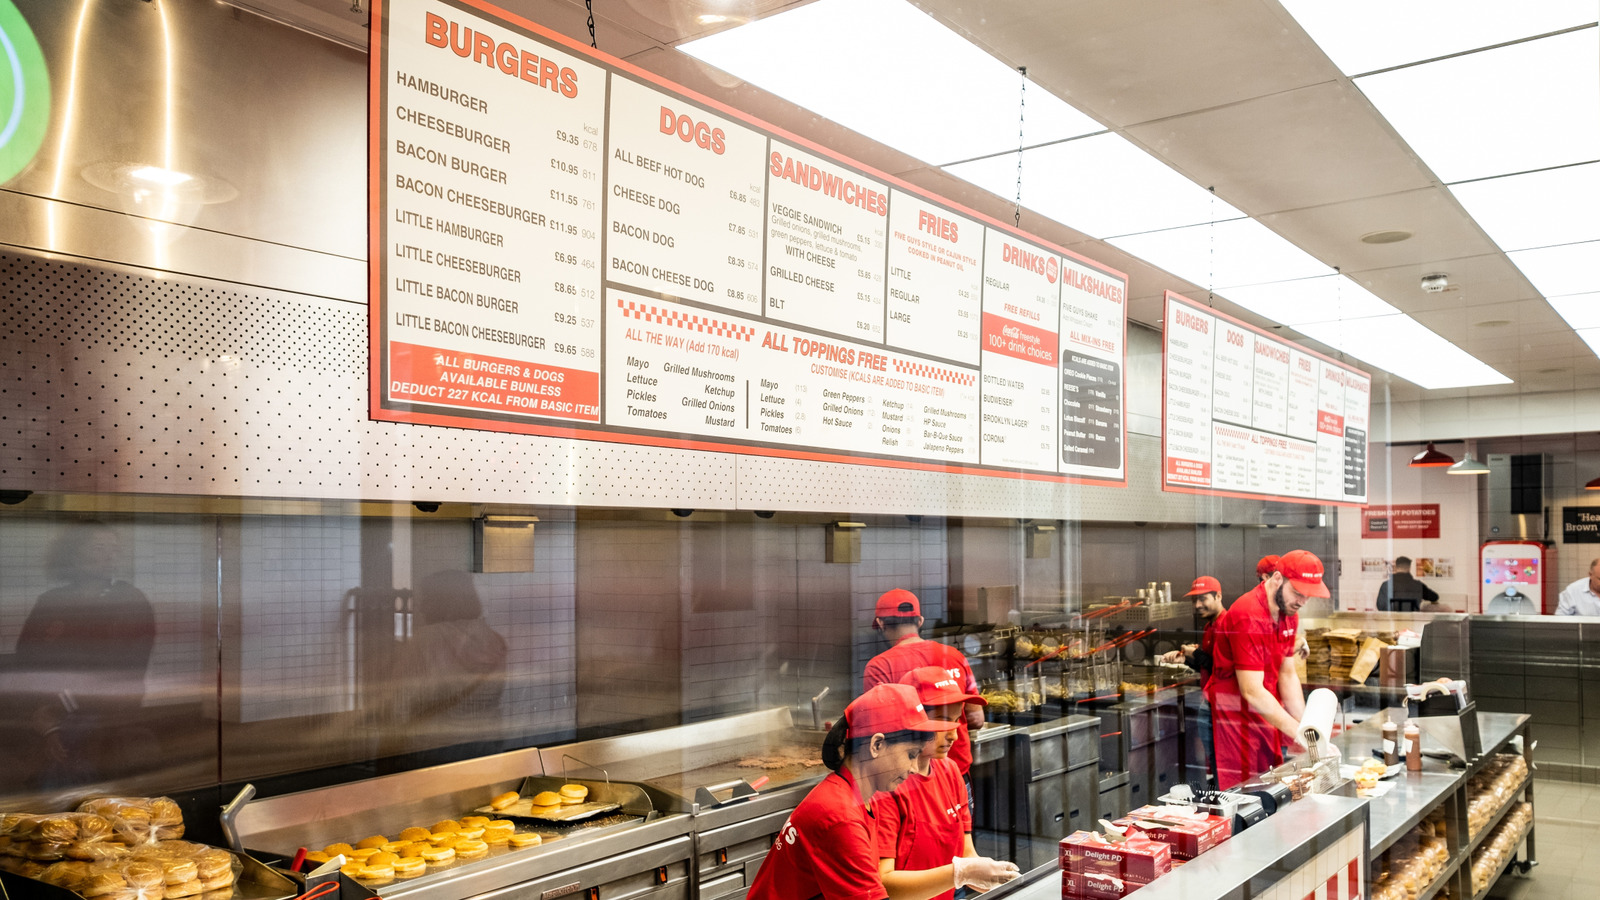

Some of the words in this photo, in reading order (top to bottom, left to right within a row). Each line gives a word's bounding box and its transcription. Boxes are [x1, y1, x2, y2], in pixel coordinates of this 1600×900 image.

[425, 12, 577, 98] BURGERS
[397, 71, 487, 113] HAMBURGER
[557, 130, 579, 145] £9.35
[397, 106, 510, 153] CHEESEBURGER
[551, 159, 578, 175] £10.95
[660, 106, 725, 155] DOGS
[397, 140, 446, 166] BACON
[452, 157, 506, 184] BURGER
[551, 190, 578, 205] £11.55
[615, 148, 633, 164] ALL
[637, 155, 661, 172] BEEF
[664, 165, 683, 180] HOT
[685, 172, 704, 188] DOG
[730, 190, 746, 203] £6.85
[770, 149, 887, 218] SANDWICHES
[397, 175, 443, 199] BACON
[447, 189, 545, 226] CHEESEBURGER
[550, 220, 577, 235] £11.95
[614, 185, 655, 207] CHEESE
[659, 199, 680, 214] DOG
[729, 223, 745, 235] £7.85
[772, 215, 790, 228] Grilled
[792, 224, 813, 236] onions,
[813, 231, 830, 241] grilled
[773, 203, 801, 221] VEGGIE
[803, 214, 842, 235] SANDWICH
[919, 210, 958, 243] FRIES
[396, 209, 433, 230] LITTLE
[437, 219, 503, 247] HAMBURGER
[555, 252, 577, 265] £6.95
[613, 221, 649, 241] BACON
[653, 232, 674, 248] DOG
[728, 256, 744, 268] £8.35
[771, 229, 788, 239] green
[789, 235, 813, 248] peppers,
[815, 241, 833, 254] lettuce
[833, 248, 838, 256] &
[840, 250, 857, 261] tomato
[786, 245, 804, 259] WITH
[807, 252, 835, 268] CHEESE
[1003, 243, 1045, 275] DRINKS
[396, 243, 432, 263] LITTLE
[436, 253, 520, 282] CHEESEBURGER
[555, 282, 576, 295] £8.65
[613, 257, 649, 276] BACON
[652, 268, 691, 287] CHEESE
[694, 278, 714, 292] DOG
[727, 289, 744, 300] £8.85
[770, 266, 803, 283] GRILLED
[806, 276, 834, 292] CHEESE
[891, 267, 911, 280] LITTLE
[986, 276, 1009, 290] REGULAR
[1063, 267, 1122, 304] MILKSHAKES
[396, 278, 433, 297] LITTLE
[437, 286, 473, 305] BACON
[477, 294, 518, 313] BURGER
[555, 312, 576, 325] £9.25
[770, 297, 785, 309] BLT
[891, 288, 919, 303] REGULAR
[890, 311, 910, 323] LARGE
[1004, 303, 1018, 314] FREE
[1019, 308, 1040, 321] REFILLS
[1176, 309, 1208, 335] BURGERS
[396, 312, 430, 330] LITTLE
[434, 319, 468, 336] BACON
[472, 326, 545, 349] CHEESEBURGER
[555, 343, 576, 355] £9.65
[625, 328, 642, 341] ALL
[646, 331, 663, 345] THE
[666, 335, 684, 348] WAY
[686, 340, 705, 353] (Add
[707, 344, 720, 356] 170
[722, 346, 739, 361] kcal)
[1019, 330, 1040, 345] freestyle
[1070, 331, 1080, 341] ALL
[1081, 334, 1101, 347] MIX-INS
[1102, 340, 1114, 351] FREE
[1226, 329, 1244, 347] DOGS
[762, 331, 788, 352] ALL
[793, 337, 855, 365] TOPPINGS
[857, 351, 888, 372] FREE
[989, 334, 1006, 348] 100+
[1008, 340, 1026, 354] drink
[1027, 345, 1052, 361] choices
[1255, 341, 1289, 364] SANDWICHES
[436, 354, 460, 368] ALL
[463, 359, 520, 376] BURGERS
[523, 368, 530, 378] &
[534, 369, 564, 382] DOGS
[627, 356, 649, 370] Mayo
[664, 362, 690, 375] Grilled
[692, 367, 735, 382] Mushrooms
[1298, 357, 1311, 372] FRIES
[440, 372, 508, 390] AVAILABLE
[510, 381, 561, 397] BUNLESS
[627, 373, 657, 386] Lettuce
[705, 385, 735, 399] Ketchup
[761, 379, 778, 390] Mayo
[811, 363, 848, 379] CUSTOMISE
[849, 371, 871, 383] (KCALS
[872, 375, 884, 386] ARE
[885, 378, 904, 389] ADDED
[906, 381, 913, 391] TO
[914, 383, 930, 394] BASIC
[931, 386, 944, 396] ITEM)
[984, 375, 1006, 386] BOTTLED
[1007, 380, 1024, 389] WATER
[391, 380, 445, 397] DEDUCT
[448, 388, 468, 400] 227
[471, 391, 502, 404] KCAL
[506, 395, 537, 408] FROM
[540, 400, 572, 412] BASIC
[575, 404, 599, 416] ITEM
[627, 389, 656, 402] Pickles
[682, 397, 707, 408] Grilled
[709, 401, 734, 412] Onions
[761, 393, 785, 405] Lettuce
[823, 389, 840, 399] Green
[842, 392, 865, 403] Peppers
[882, 399, 904, 410] Ketchup
[984, 394, 1012, 406] BUDWEISER
[627, 405, 667, 419] Tomatoes
[705, 415, 735, 427] Mustard
[761, 408, 784, 419] Pickles
[823, 402, 842, 413] Grilled
[844, 406, 863, 416] Onions
[882, 412, 903, 422] Mustard
[984, 414, 1010, 425] BROOKLYN
[1012, 419, 1027, 428] LAGER
[761, 422, 792, 434] Tomatoes
[823, 417, 833, 425] Hot
[835, 418, 852, 428] Sauce
[882, 424, 900, 434] Onions
[983, 433, 1004, 443] CORONA
[1260, 435, 1278, 447] TOPPINGS
[1279, 440, 1287, 449] FREE
[1565, 523, 1598, 531] Brown
[1085, 850, 1110, 861] Delight
[1087, 881, 1112, 891] Delight
